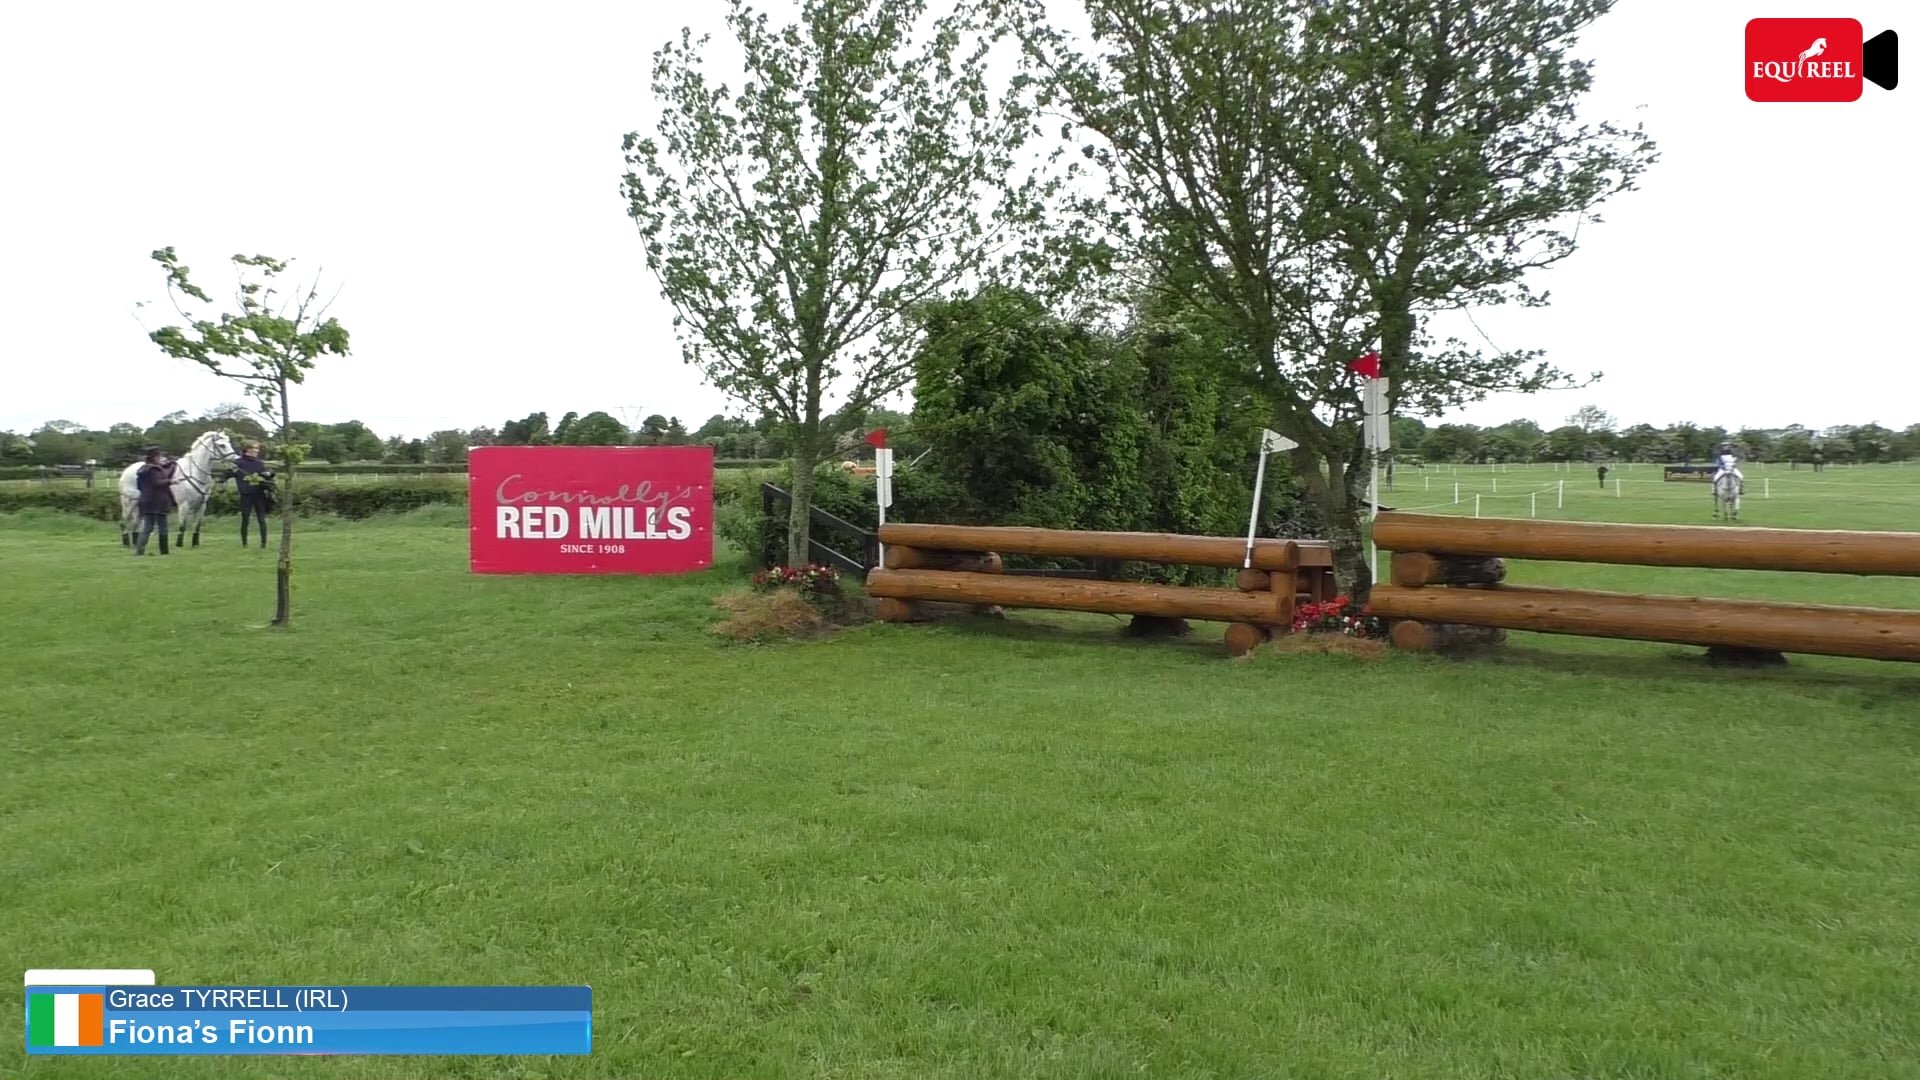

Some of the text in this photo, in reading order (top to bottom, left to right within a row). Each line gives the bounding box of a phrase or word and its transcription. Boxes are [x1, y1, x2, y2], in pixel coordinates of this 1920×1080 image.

[496, 474, 691, 525] Connolly's
[496, 506, 691, 540] RED MILLS
[560, 544, 625, 554] SINCE 1908
